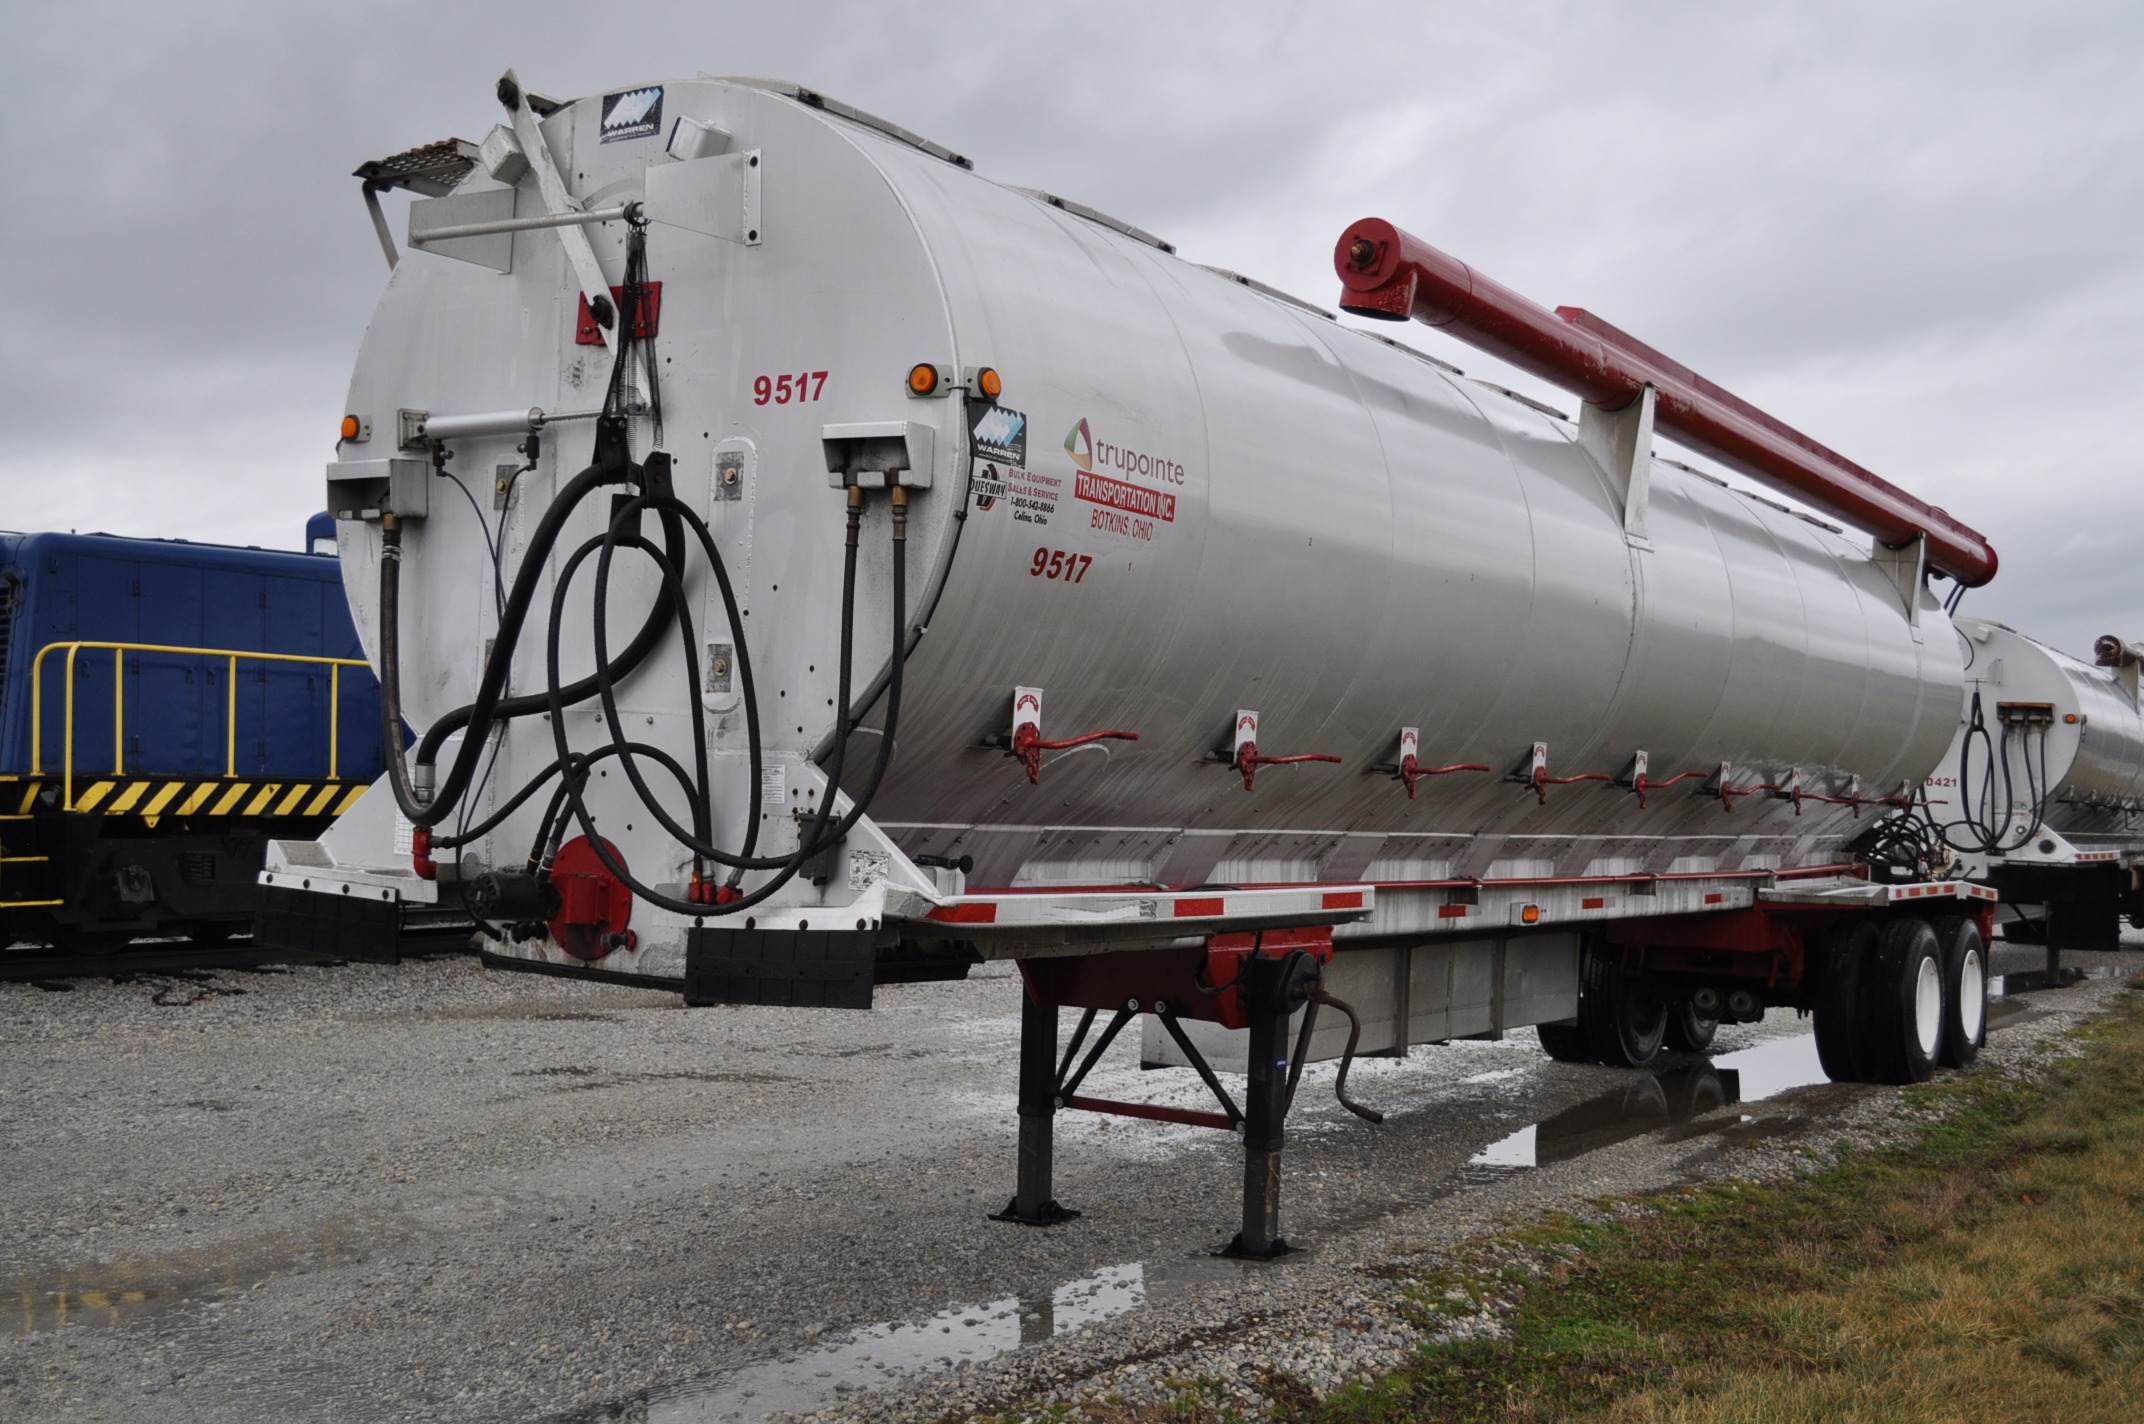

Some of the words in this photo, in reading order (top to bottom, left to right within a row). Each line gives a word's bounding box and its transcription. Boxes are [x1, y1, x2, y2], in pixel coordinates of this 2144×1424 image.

[607, 123, 655, 137] WARREN
[753, 371, 829, 405] 9517
[977, 443, 1021, 461] WARREN
[1096, 438, 1185, 486] trupointe
[970, 478, 1006, 497] DUESWAY
[1077, 473, 1157, 515] TRANSPORTATION
[1157, 494, 1174, 519] INC.
[1034, 513, 1048, 526] Ohio
[1132, 518, 1154, 541] OHIO
[1030, 547, 1093, 583] 9517
[1926, 777, 1957, 788] 0421
